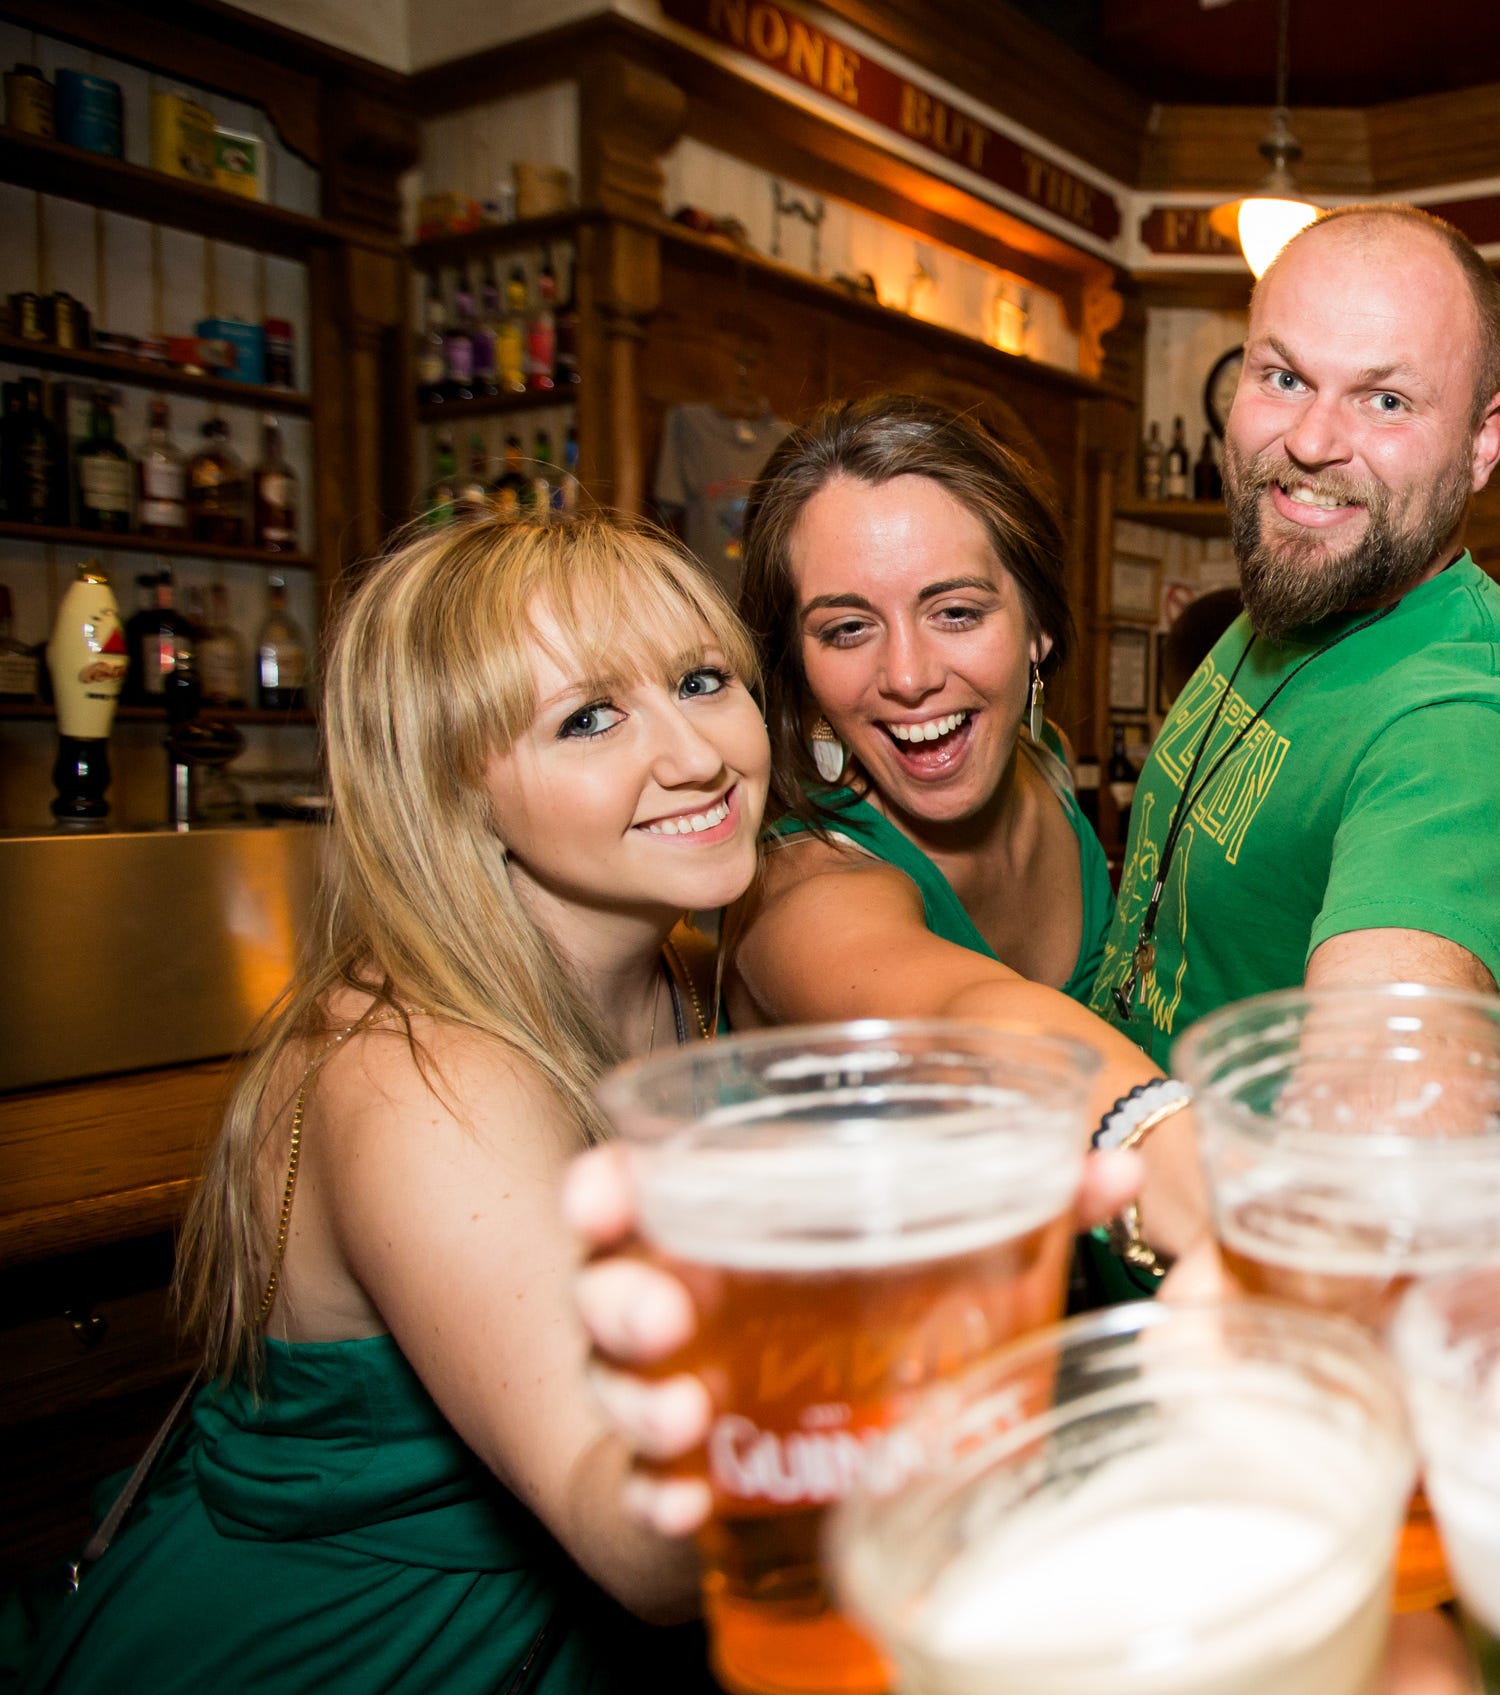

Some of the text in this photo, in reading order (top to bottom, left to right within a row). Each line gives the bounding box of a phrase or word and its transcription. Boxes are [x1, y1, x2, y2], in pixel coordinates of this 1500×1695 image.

[706, 0, 1095, 228] NONE BUT THE
